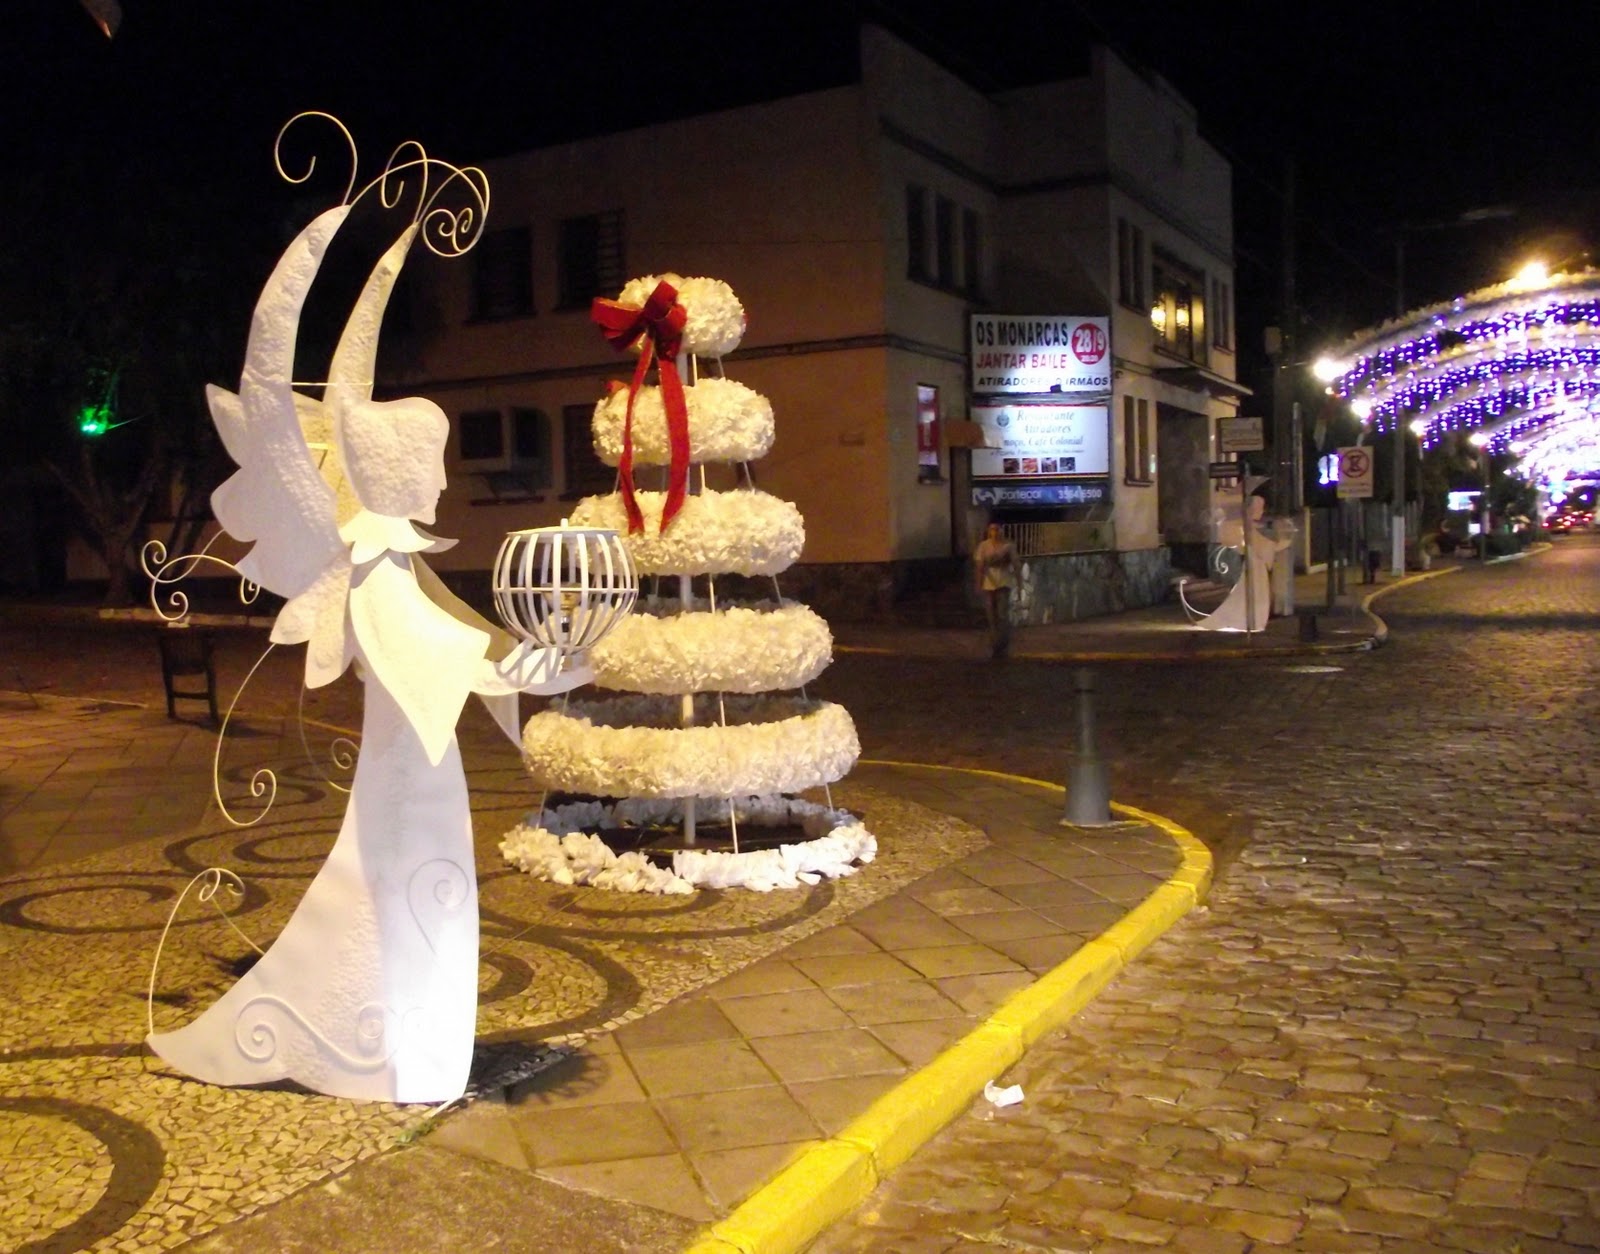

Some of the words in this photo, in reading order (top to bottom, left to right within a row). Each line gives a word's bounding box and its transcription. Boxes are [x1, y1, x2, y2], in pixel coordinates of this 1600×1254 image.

[976, 321, 994, 346] OS
[998, 321, 1068, 347] MONARCAS
[1075, 328, 1105, 353] 28/9
[976, 353, 1026, 369] JANTAR
[1031, 353, 1067, 369] BAILE
[1065, 375, 1109, 386] IRMÃOS
